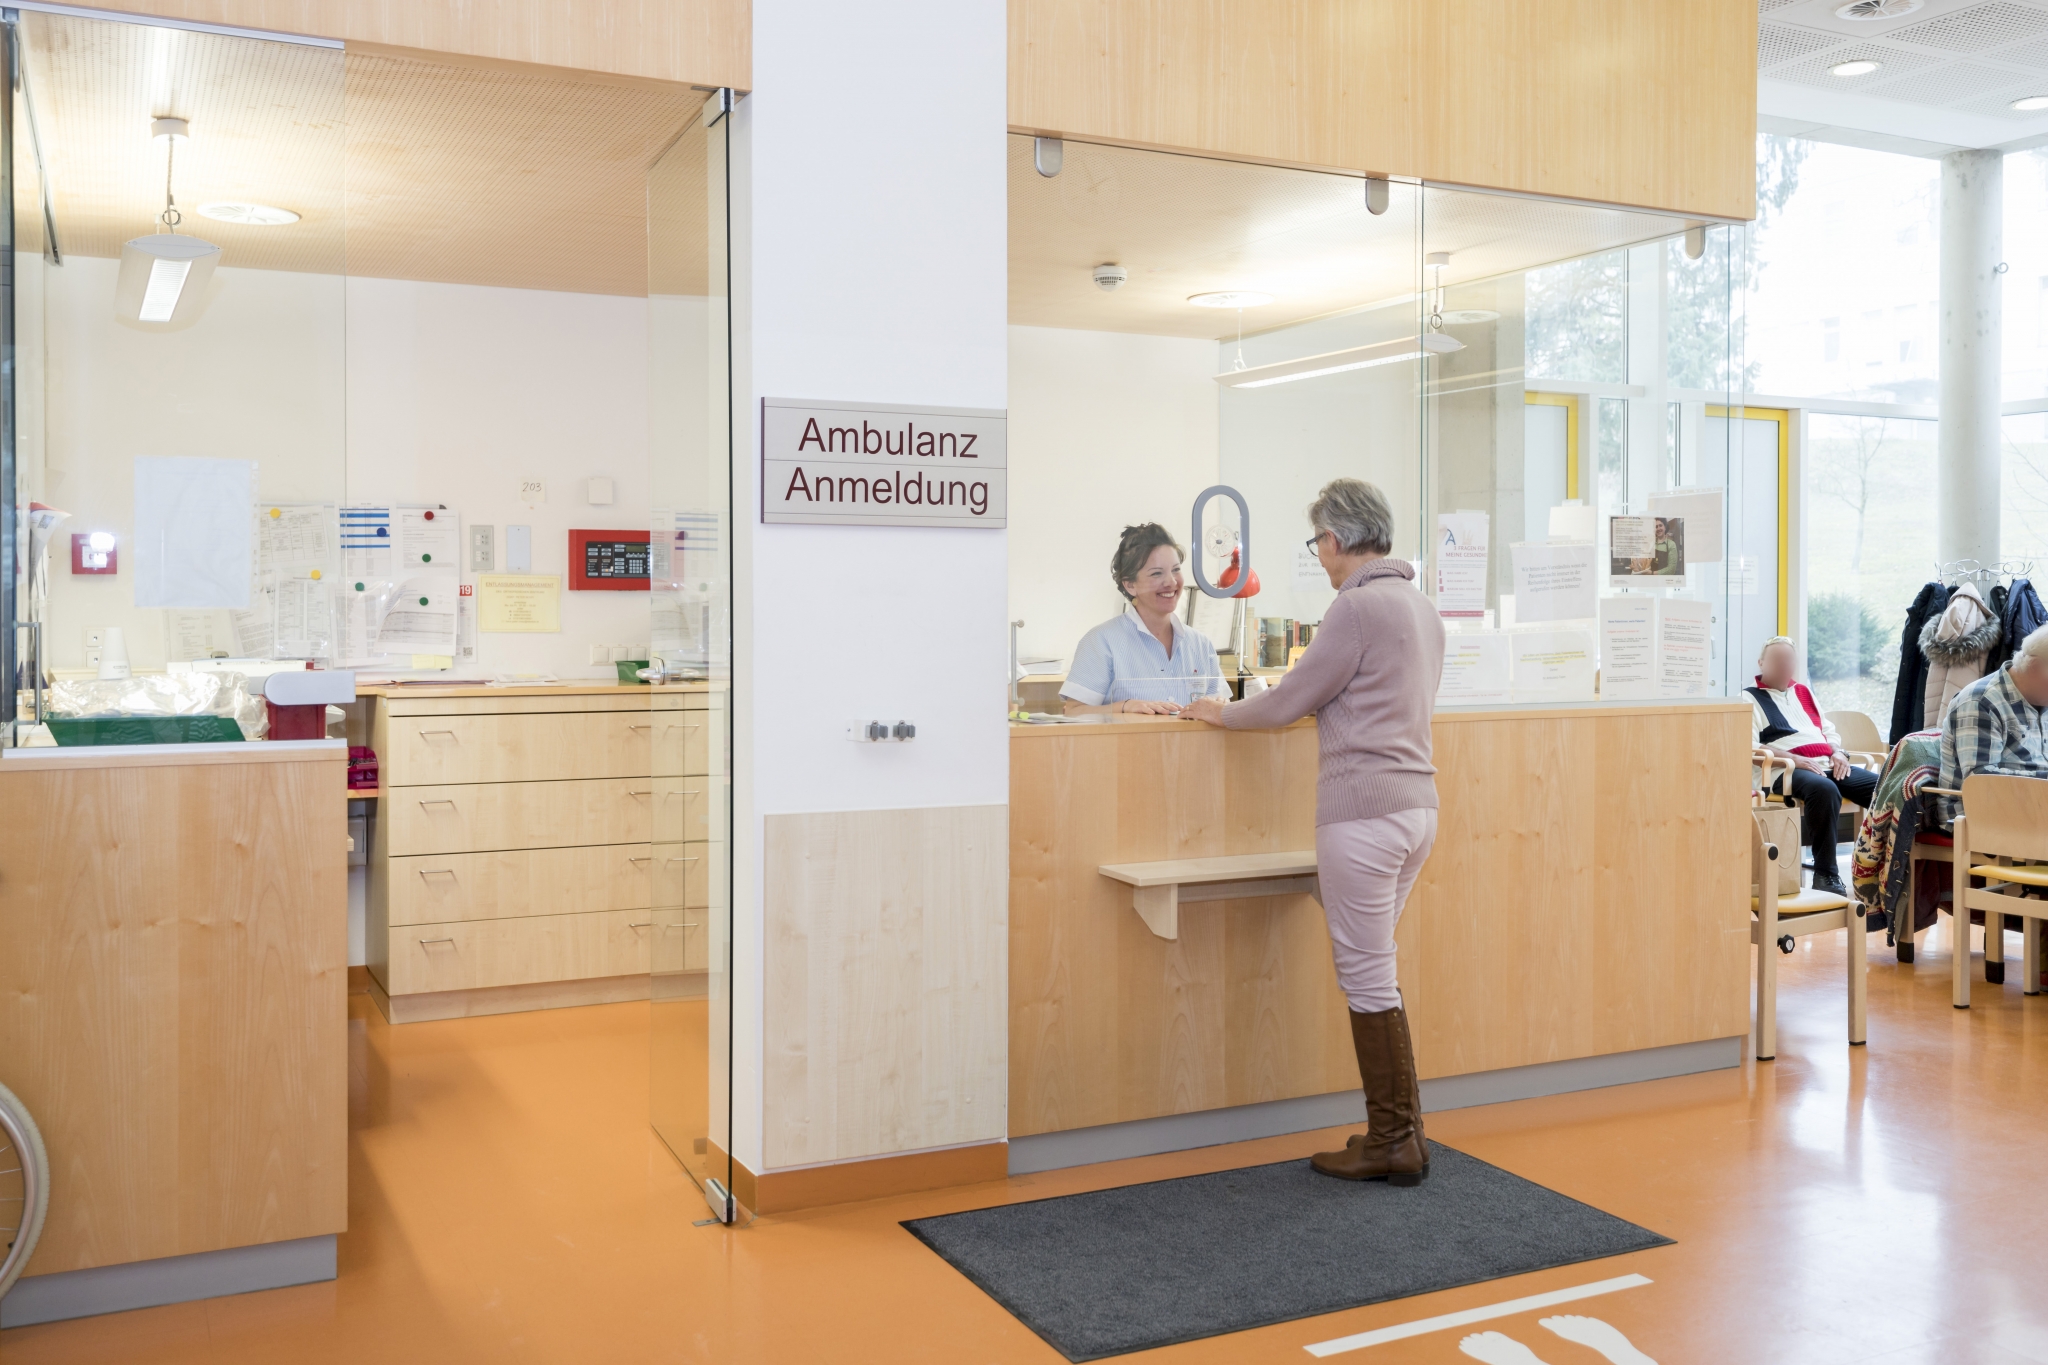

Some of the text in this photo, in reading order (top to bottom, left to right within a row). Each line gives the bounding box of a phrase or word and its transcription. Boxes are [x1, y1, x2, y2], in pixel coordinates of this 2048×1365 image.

[798, 417, 979, 459] Ambulanz
[522, 482, 542, 492] 203
[784, 466, 989, 516] Anmeldung
